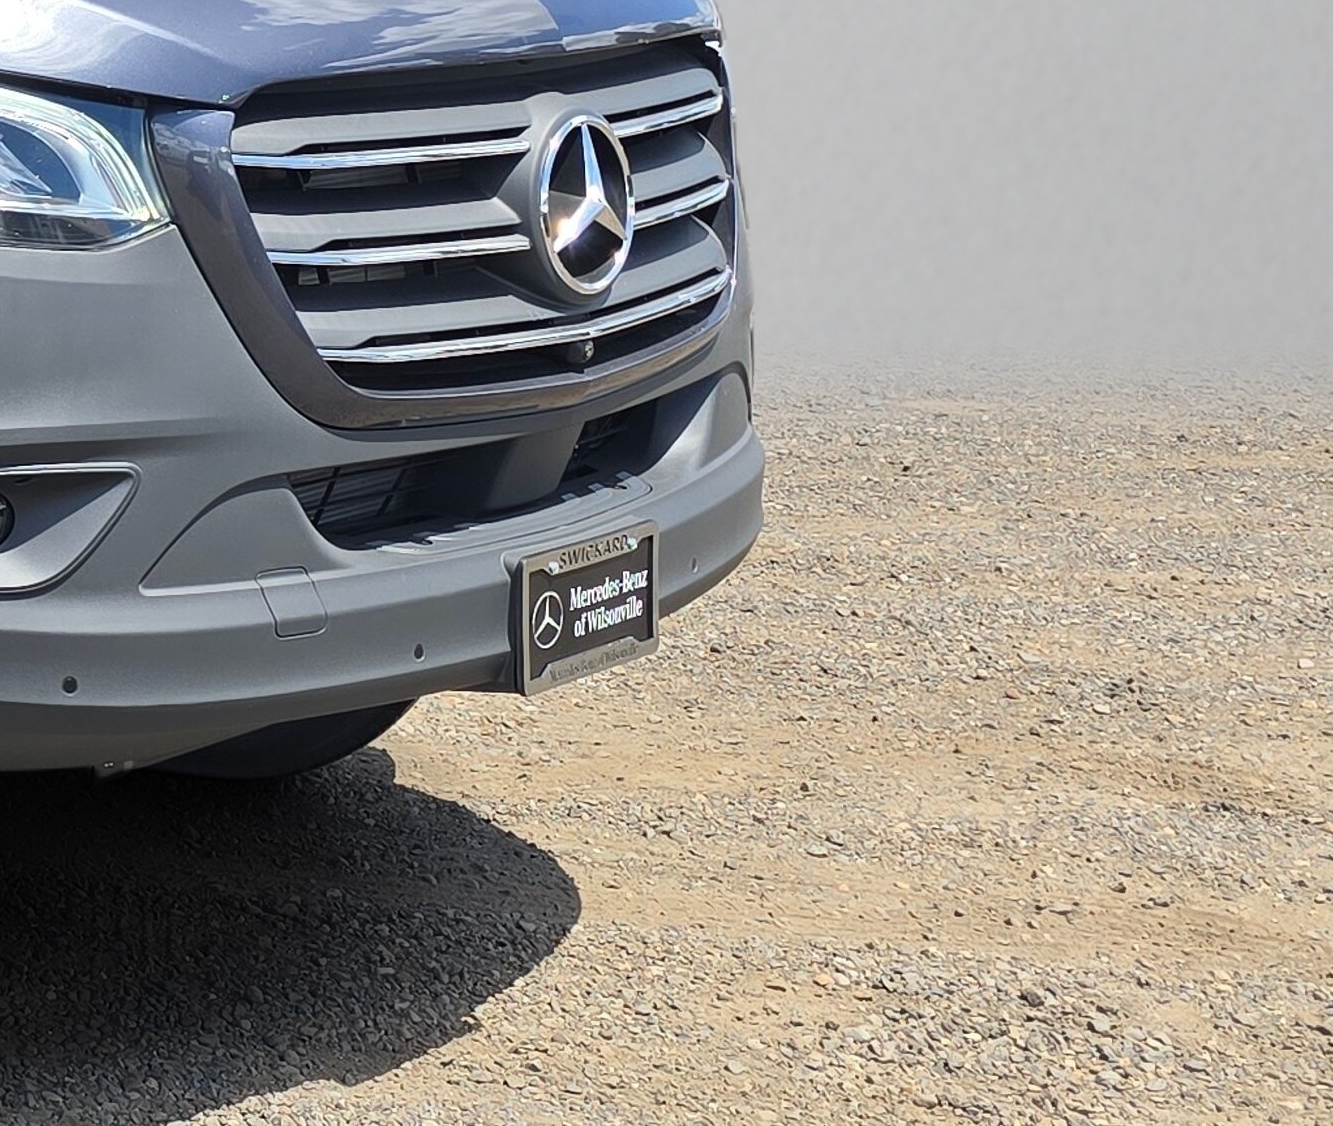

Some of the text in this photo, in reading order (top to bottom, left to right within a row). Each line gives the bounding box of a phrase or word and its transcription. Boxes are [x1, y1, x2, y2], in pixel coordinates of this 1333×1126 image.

[558, 535, 630, 570] SWICKARD
[569, 569, 648, 611] Mercedes-Benz
[574, 596, 643, 637] of Wilsonville
